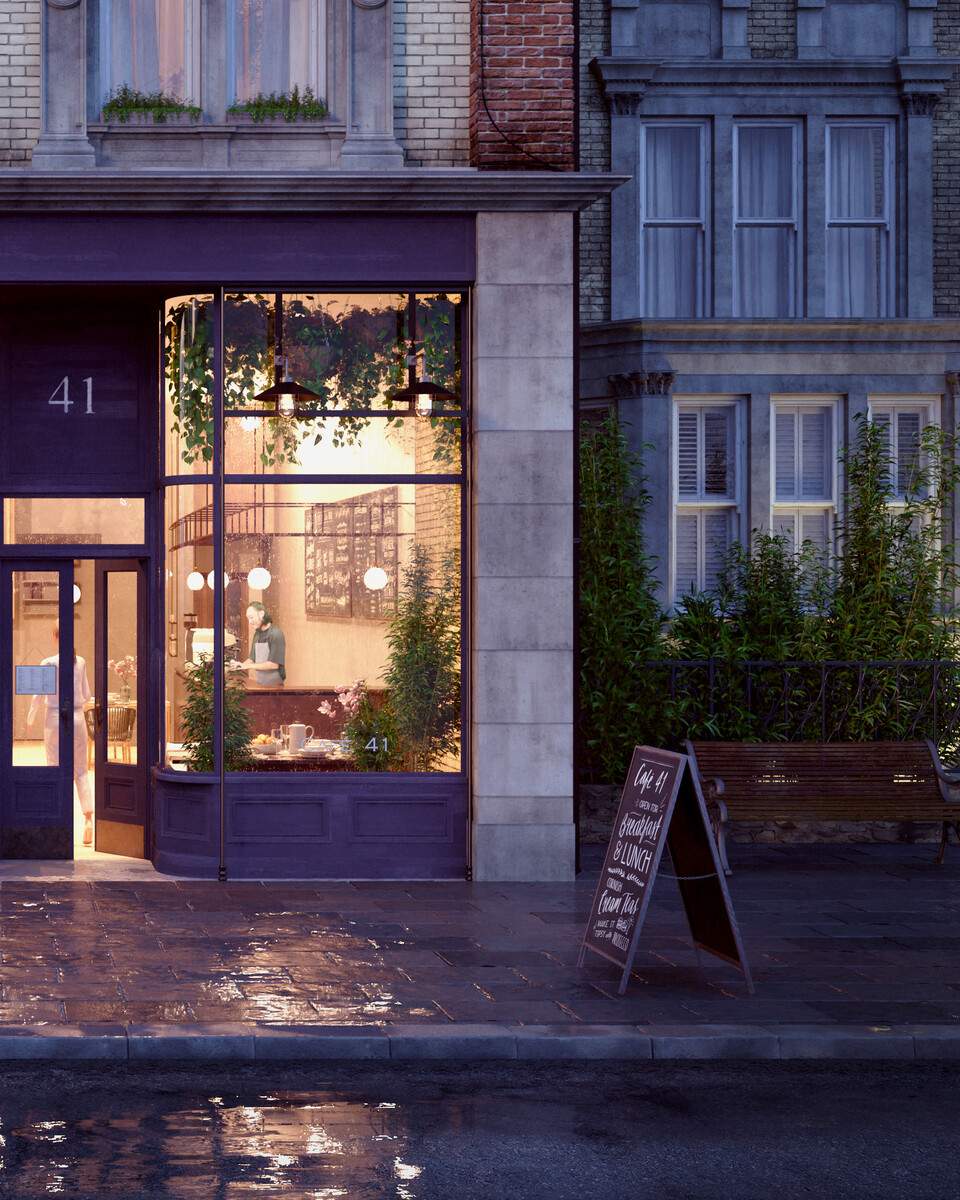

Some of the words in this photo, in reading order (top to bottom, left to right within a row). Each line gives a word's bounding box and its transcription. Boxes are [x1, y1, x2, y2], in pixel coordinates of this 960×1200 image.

[48, 376, 96, 414] 41
[301, 736, 352, 752] CAFÉ
[364, 737, 388, 752] 41
[654, 770, 669, 794] 41
[639, 800, 650, 811] OPEN
[650, 803, 659, 813] FOR
[618, 813, 663, 844] Breakfast
[620, 842, 653, 874] LUNCH
[597, 889, 622, 915] Cream
